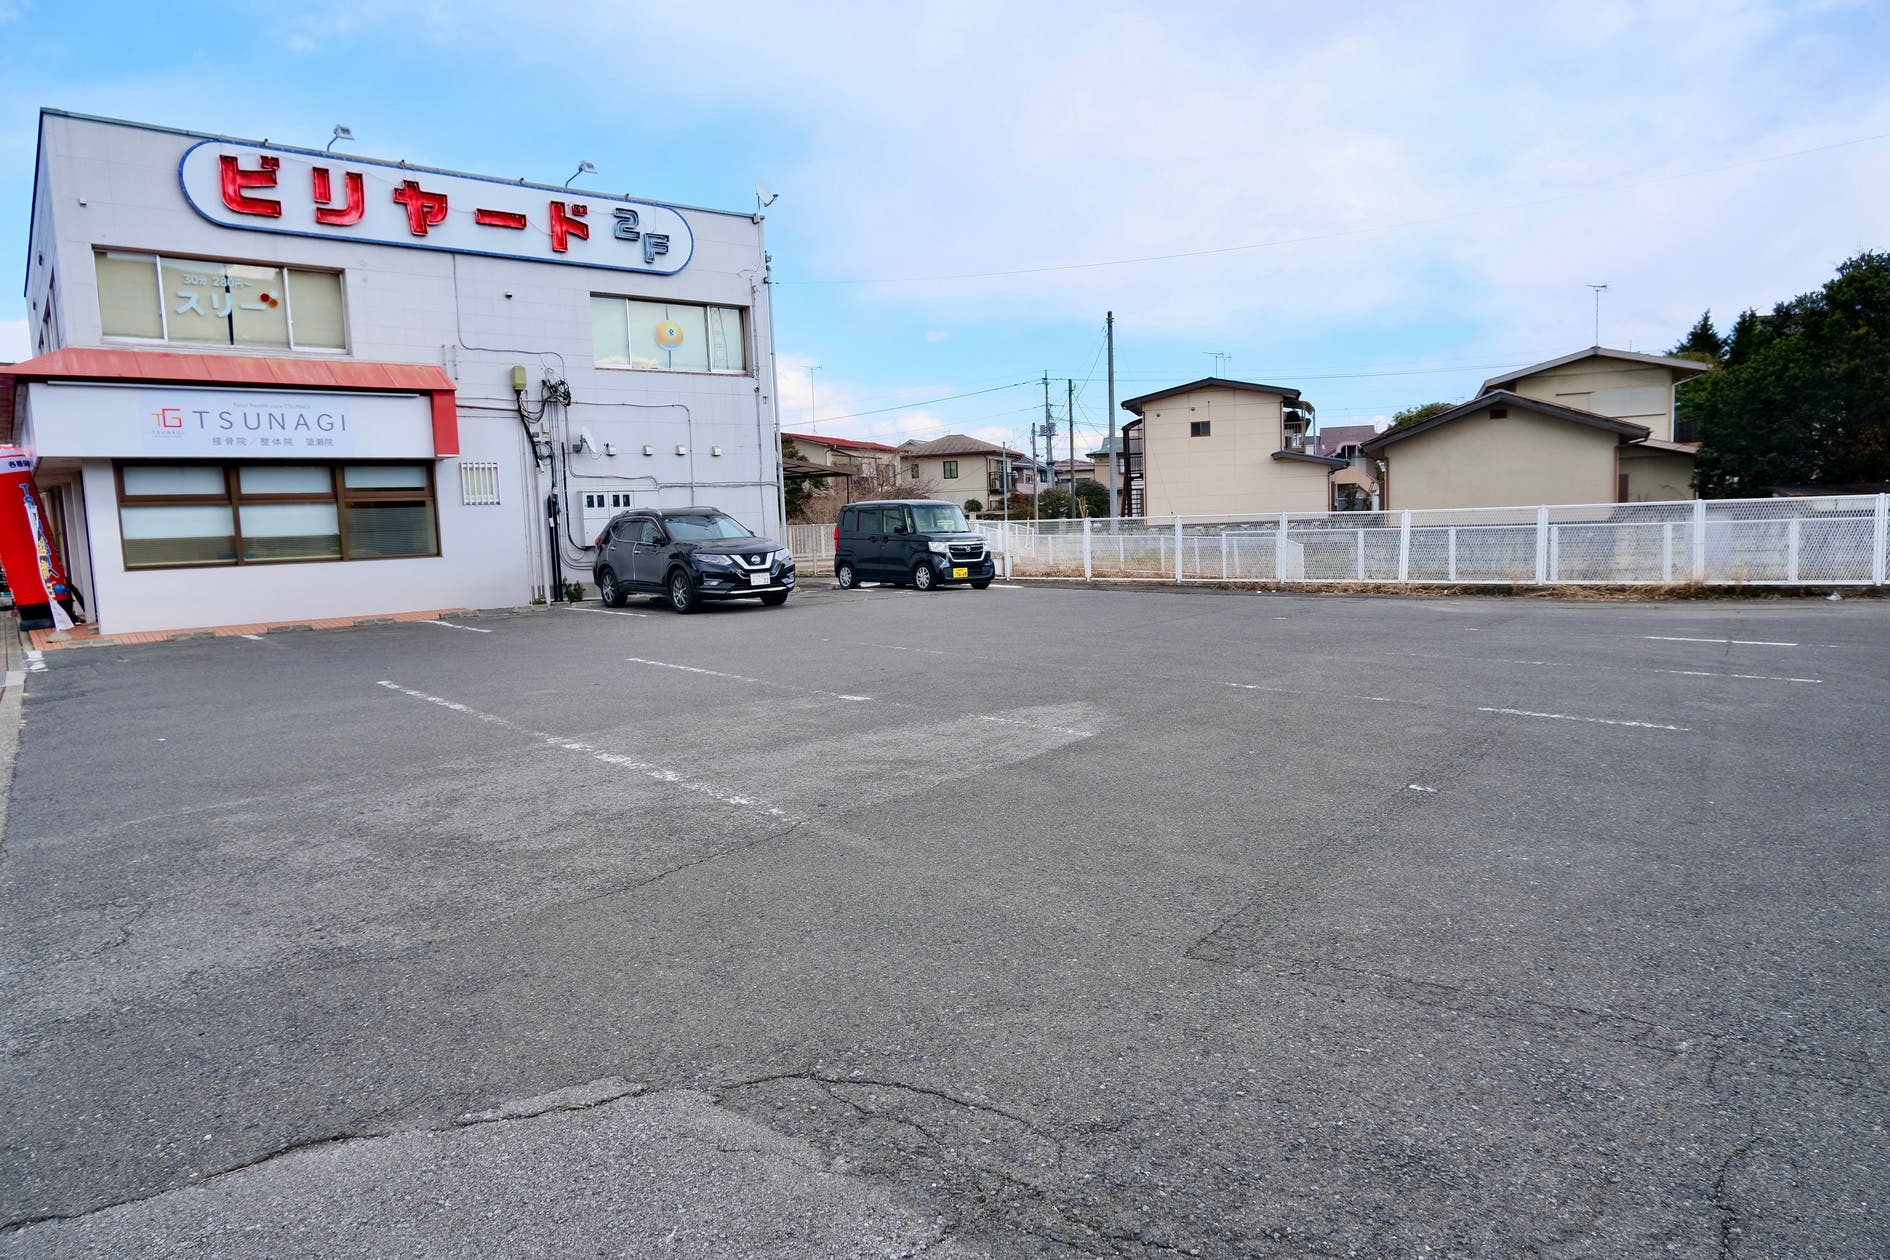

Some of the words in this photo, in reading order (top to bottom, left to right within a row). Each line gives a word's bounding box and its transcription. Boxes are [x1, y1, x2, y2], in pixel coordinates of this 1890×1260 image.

[219, 154, 590, 253] ビリヤード
[613, 206, 671, 265] 2F
[192, 410, 346, 432] TSUNAGI
